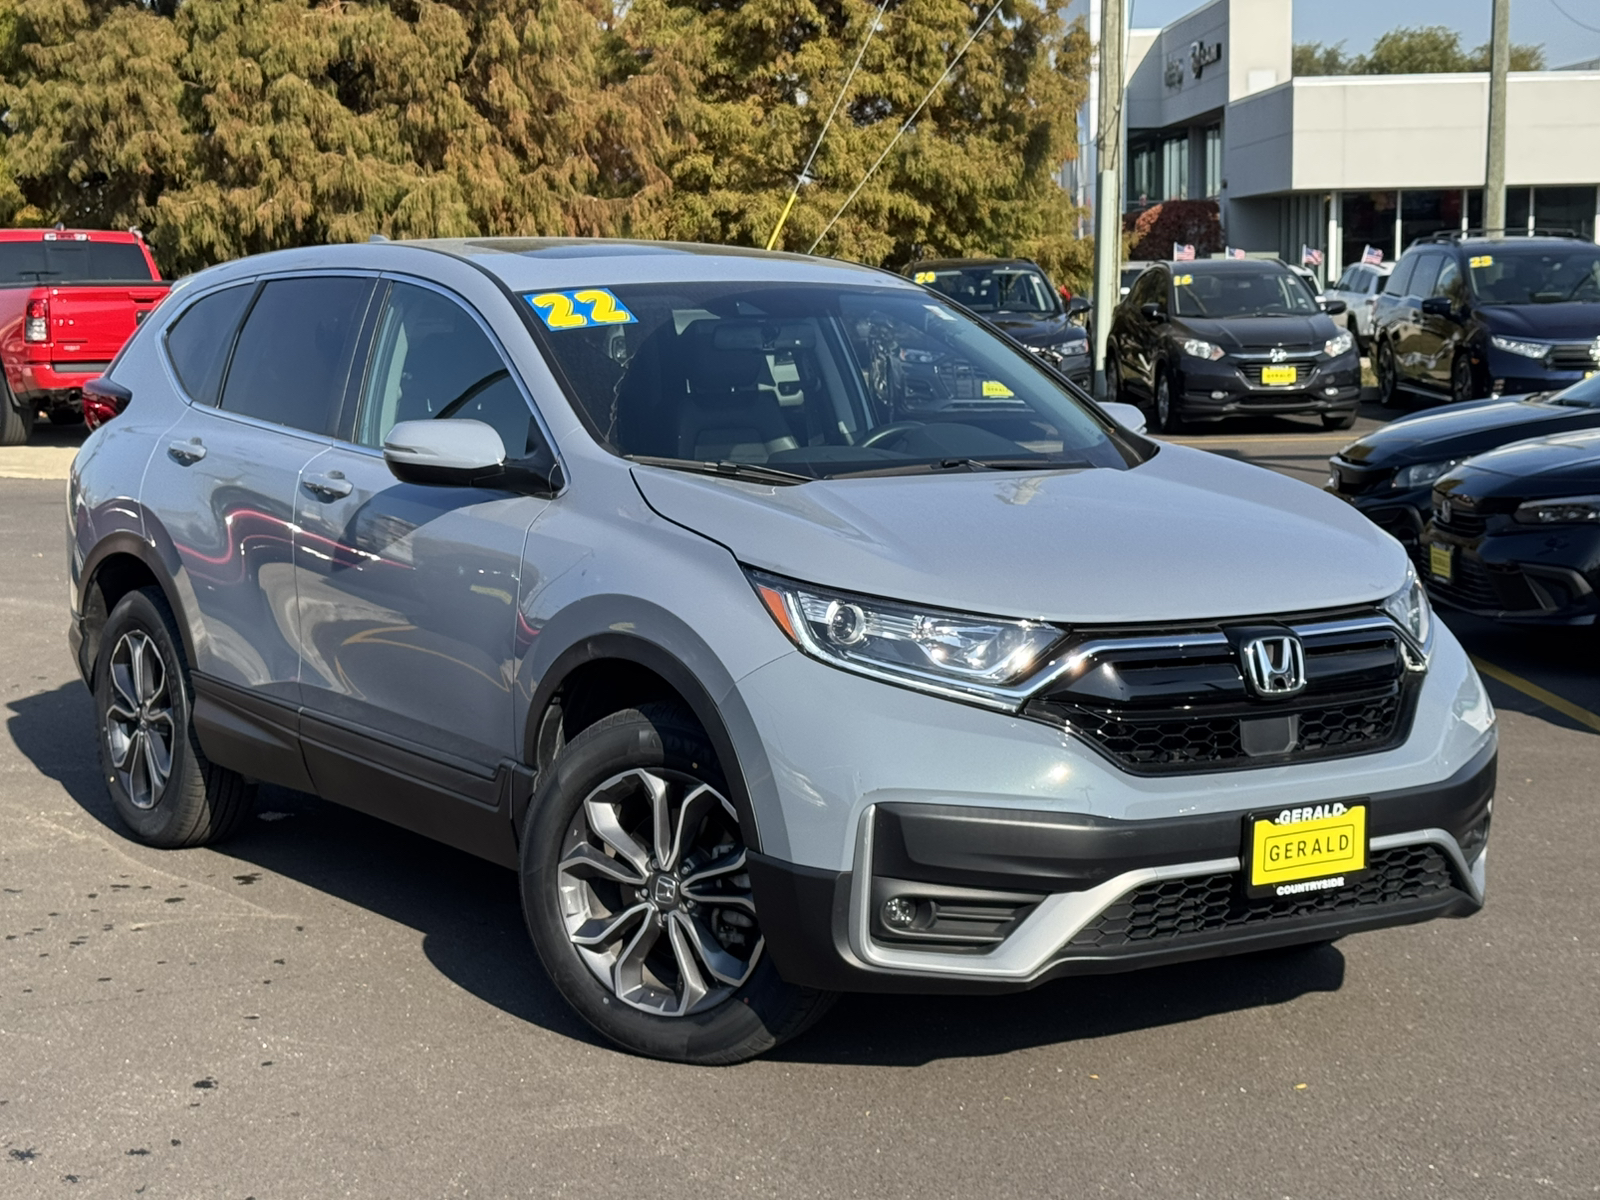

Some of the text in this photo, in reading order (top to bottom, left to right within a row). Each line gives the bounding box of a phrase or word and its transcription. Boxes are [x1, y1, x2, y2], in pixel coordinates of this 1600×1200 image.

[532, 290, 630, 328] 22
[1278, 802, 1346, 825] GERALD
[1269, 834, 1350, 862] GERALD
[1276, 877, 1345, 896] COUNTRYSIDE
